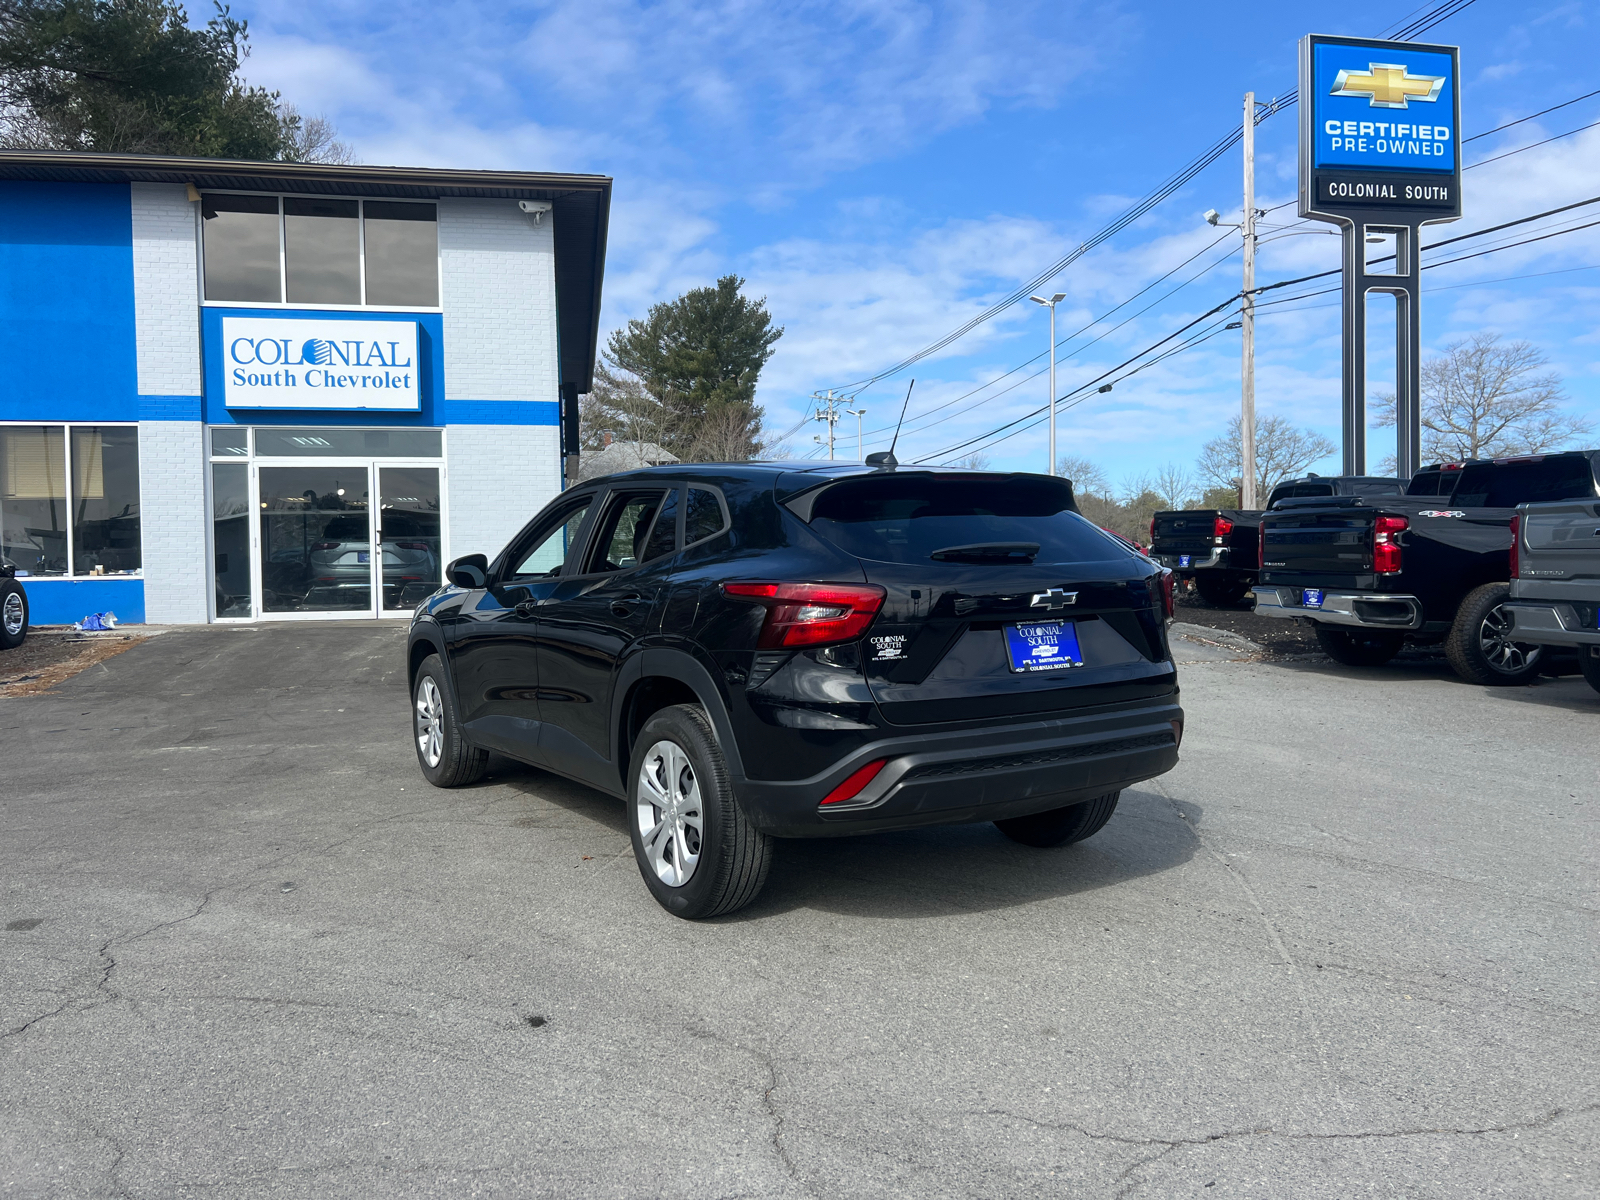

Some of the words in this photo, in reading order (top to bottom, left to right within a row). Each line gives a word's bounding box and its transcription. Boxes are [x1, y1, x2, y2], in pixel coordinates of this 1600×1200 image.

[1325, 120, 1450, 141] CERTIFIED
[1331, 137, 1444, 156] PRE-OWNED
[1329, 182, 1397, 199] COLONIAL
[1405, 185, 1448, 201] SOUTH
[230, 337, 411, 368] COLONIAL
[233, 368, 297, 388] South
[304, 369, 411, 389] Chevrolet
[870, 635, 908, 644] COLONIAL
[1019, 626, 1062, 637] COLONIAL
[1027, 635, 1058, 646] SOUTH
[876, 642, 902, 650] SOUTH
